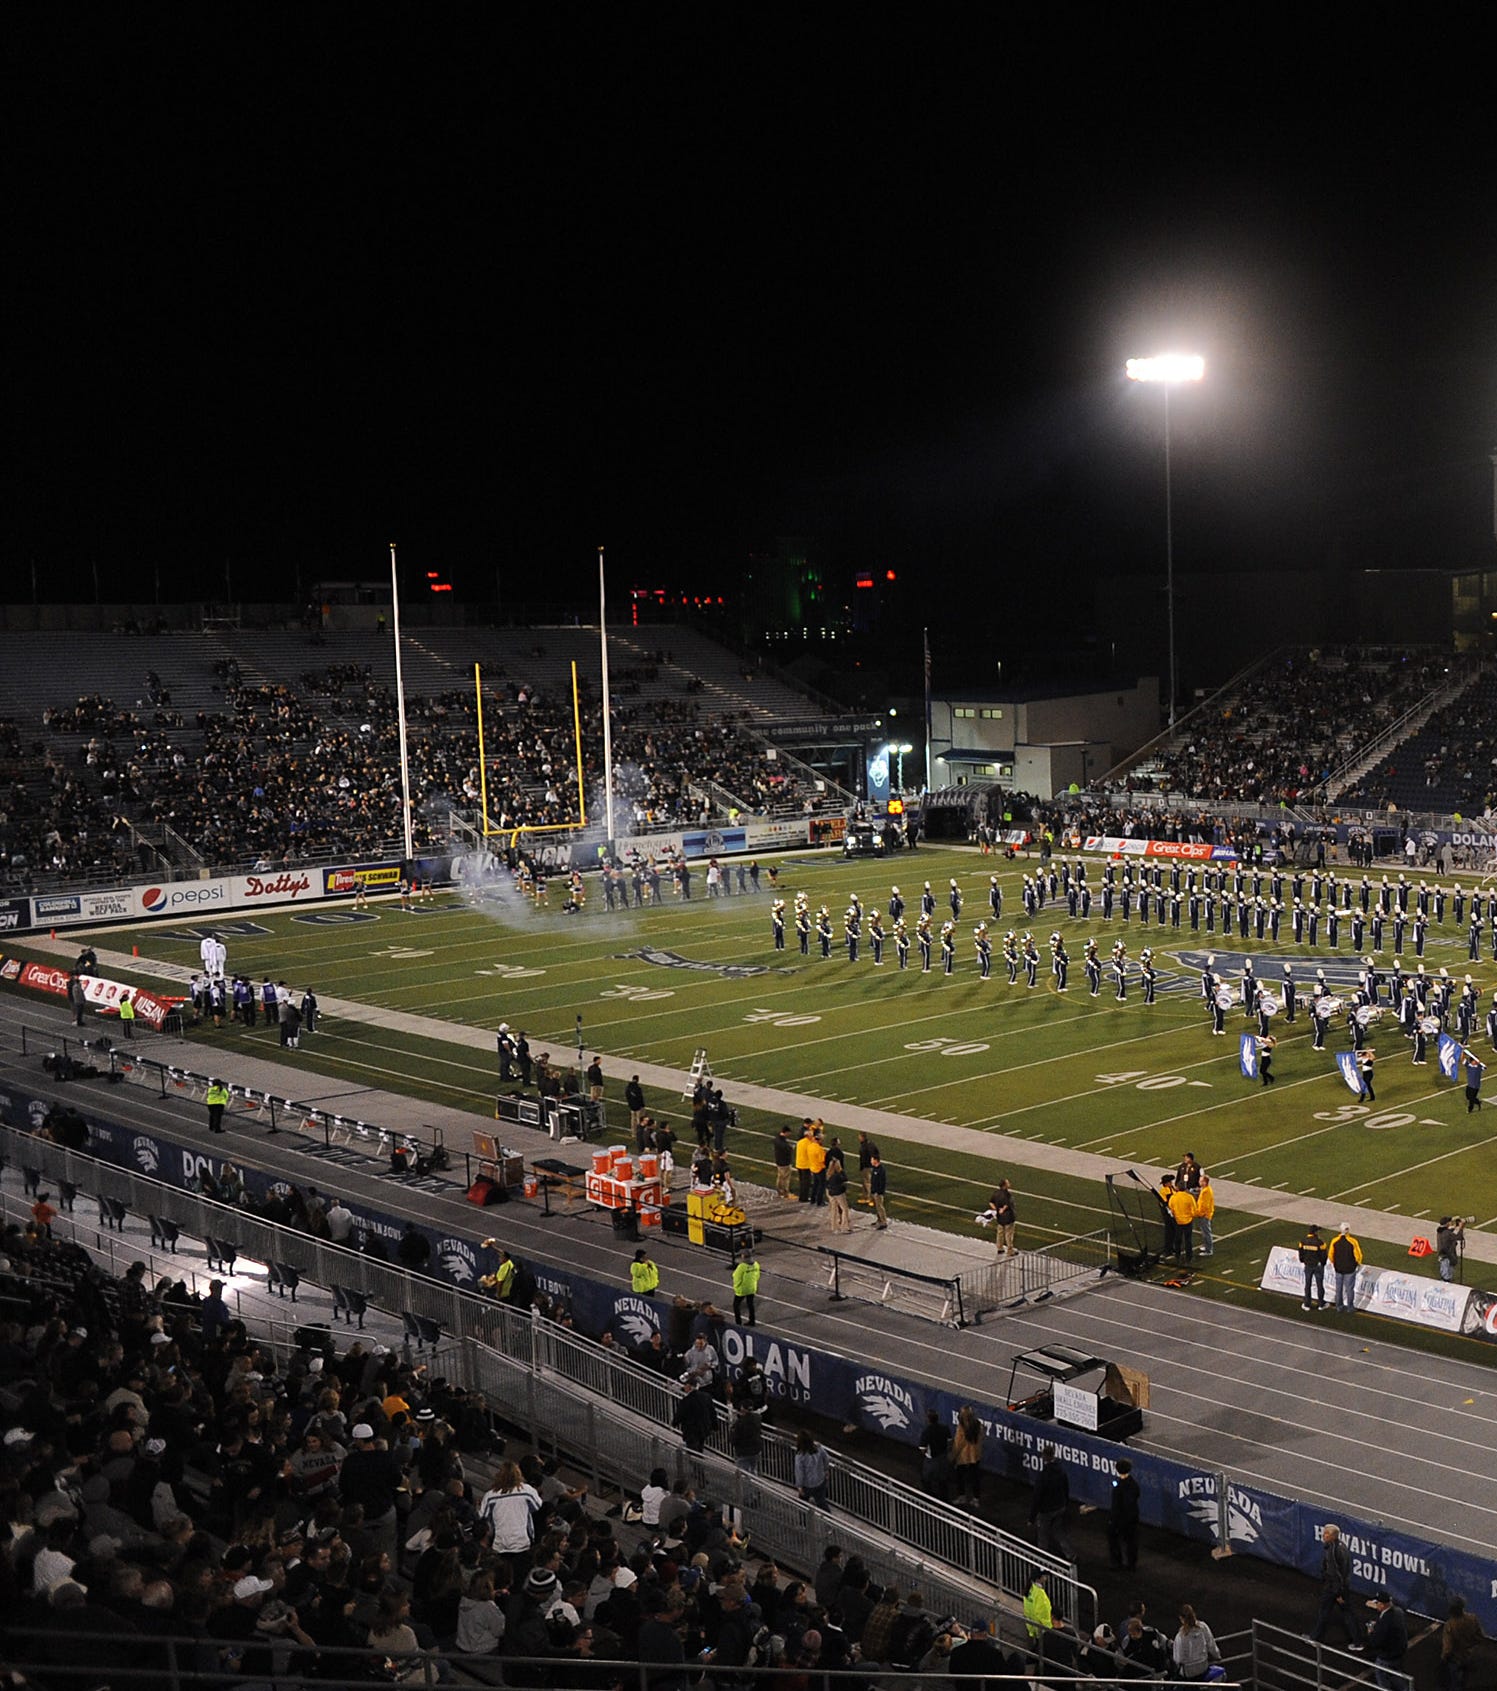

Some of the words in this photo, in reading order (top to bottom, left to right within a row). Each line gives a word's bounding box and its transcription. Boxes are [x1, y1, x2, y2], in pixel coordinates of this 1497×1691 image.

[770, 724, 828, 736] community
[1152, 842, 1179, 855] Great
[1181, 844, 1205, 857] Clips
[171, 884, 224, 908] pepsi
[244, 873, 310, 898] Dotty's
[28, 966, 51, 985] Great
[600, 984, 675, 1000] 30
[742, 1008, 823, 1027] 40
[904, 1037, 990, 1056] 50
[1095, 1070, 1187, 1090] 40
[1313, 1105, 1417, 1129] 30
[133, 1136, 160, 1160] NEVADA
[436, 1238, 477, 1268] NEVADA
[1411, 1238, 1425, 1254] 20
[548, 1279, 573, 1298] BOWL
[614, 1297, 661, 1330] NEVADA
[715, 1328, 811, 1389] OLAN
[765, 1379, 812, 1404] ROUP
[855, 1375, 914, 1414] NEVADA
[996, 1423, 1033, 1449] FIGHT
[1021, 1452, 1045, 1472] 201
[1178, 1477, 1263, 1527] NEVADA
[1313, 1524, 1377, 1560] HWAI'I
[1380, 1546, 1431, 1577] BOWL
[1352, 1559, 1387, 1585] 2011
